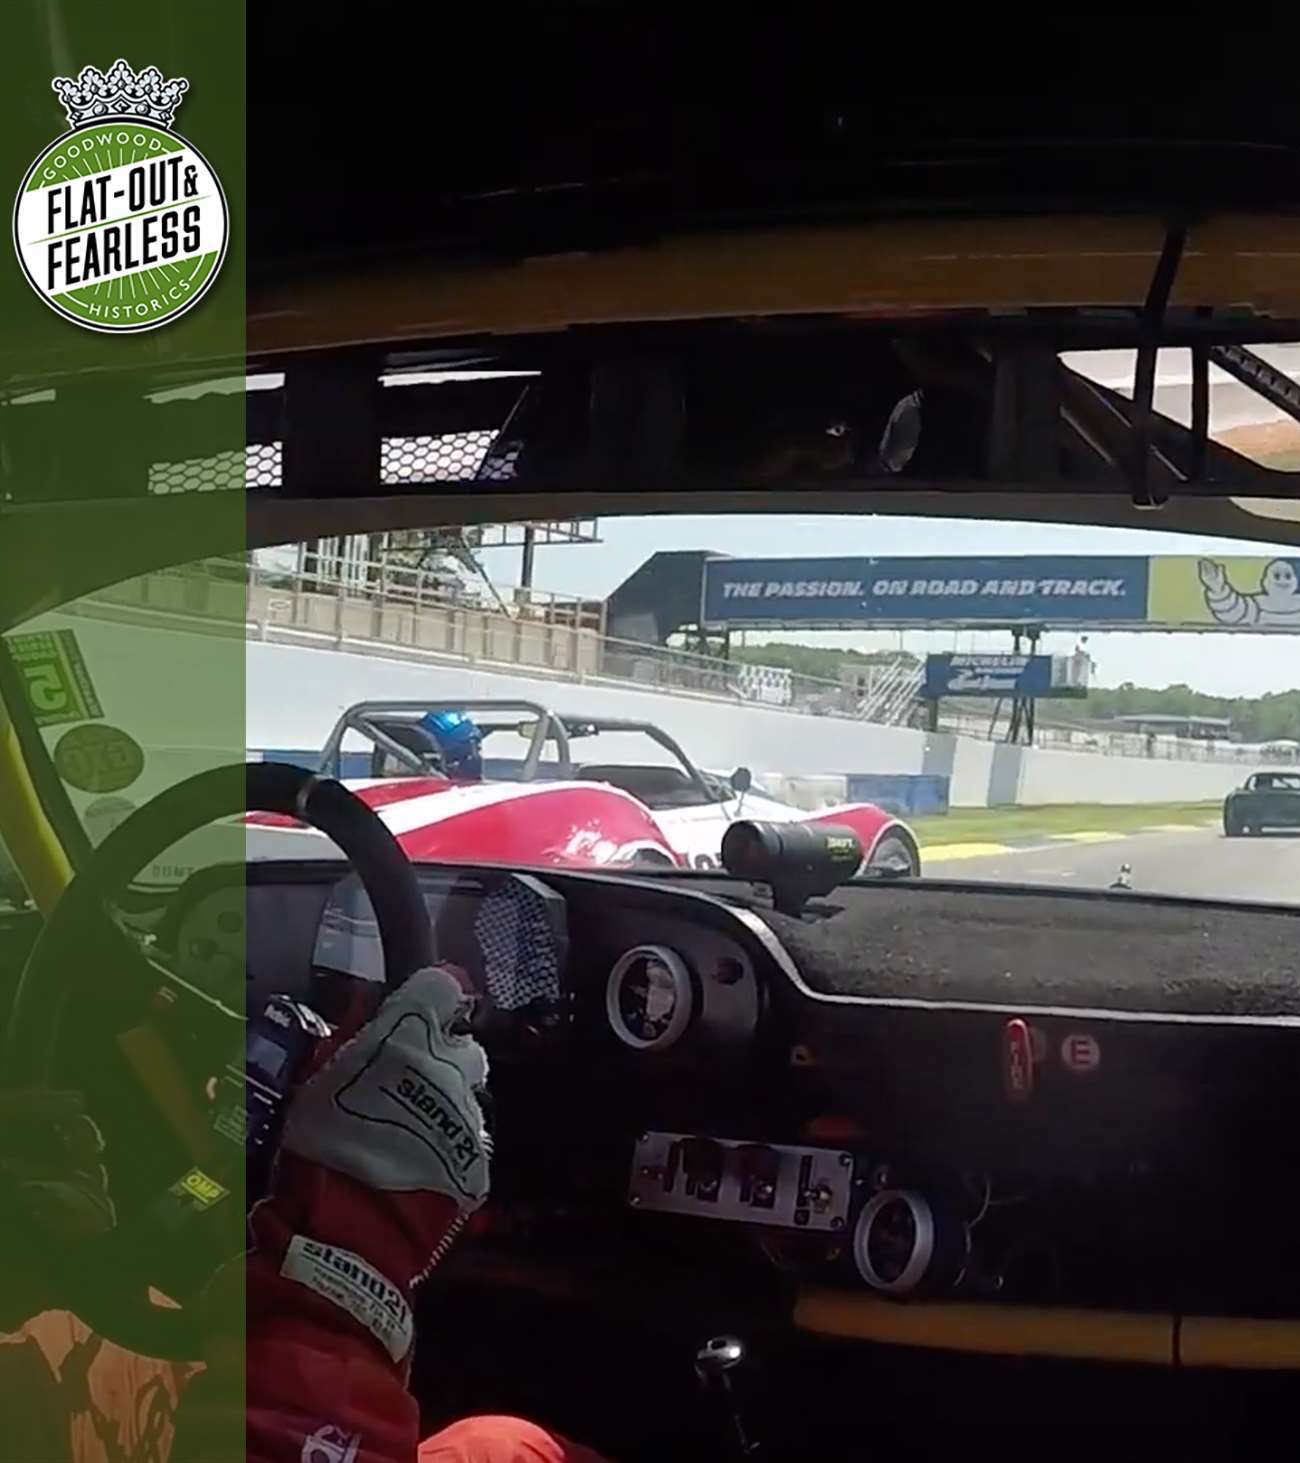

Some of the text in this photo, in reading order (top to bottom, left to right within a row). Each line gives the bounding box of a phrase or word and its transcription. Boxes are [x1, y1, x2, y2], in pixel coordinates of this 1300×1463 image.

[723, 578, 1126, 599] THE PASSION. ON ROAD AND TRACK.
[1071, 1039, 1090, 1064] E
